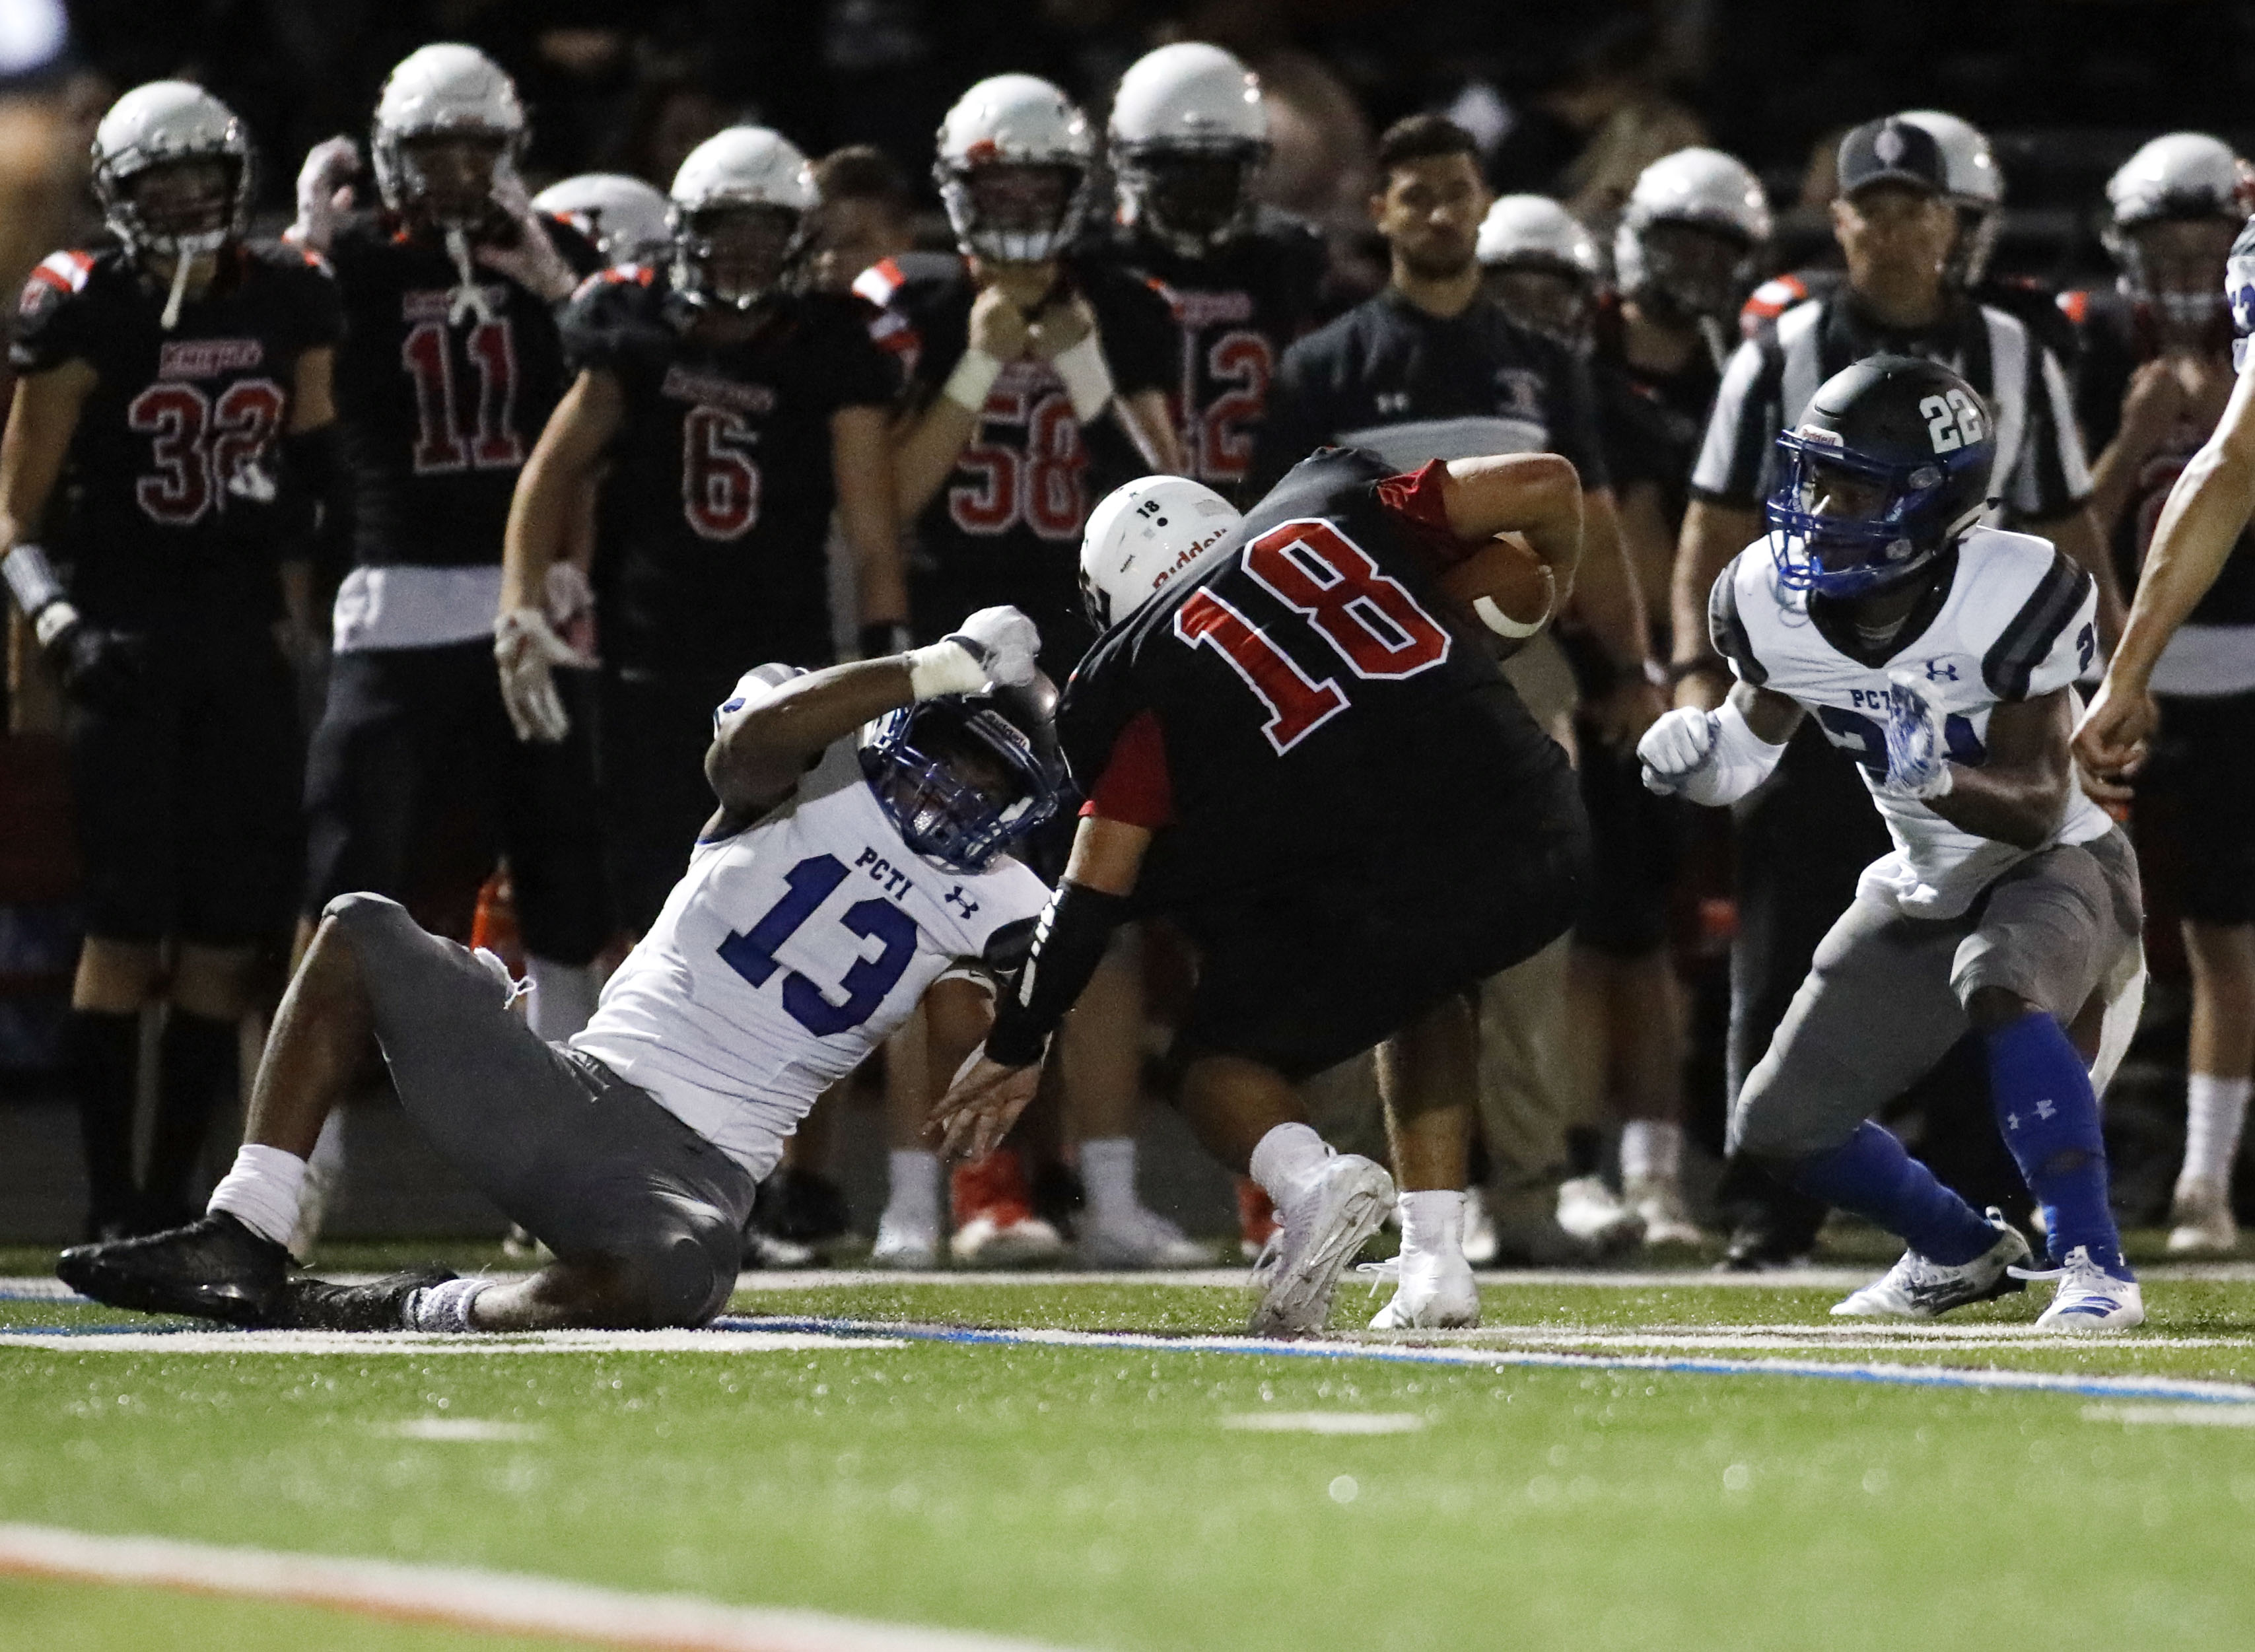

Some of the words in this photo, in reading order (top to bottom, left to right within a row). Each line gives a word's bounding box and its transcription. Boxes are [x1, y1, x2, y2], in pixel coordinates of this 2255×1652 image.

[128, 376, 285, 526] 32
[400, 317, 525, 477] 11
[681, 403, 762, 541] 6
[948, 390, 1086, 541] 58
[1920, 388, 1984, 454] 22
[1136, 500, 1160, 519] 18
[1174, 518, 1451, 757] 18
[716, 852, 919, 1037] 13
[853, 846, 915, 901] PCTI
